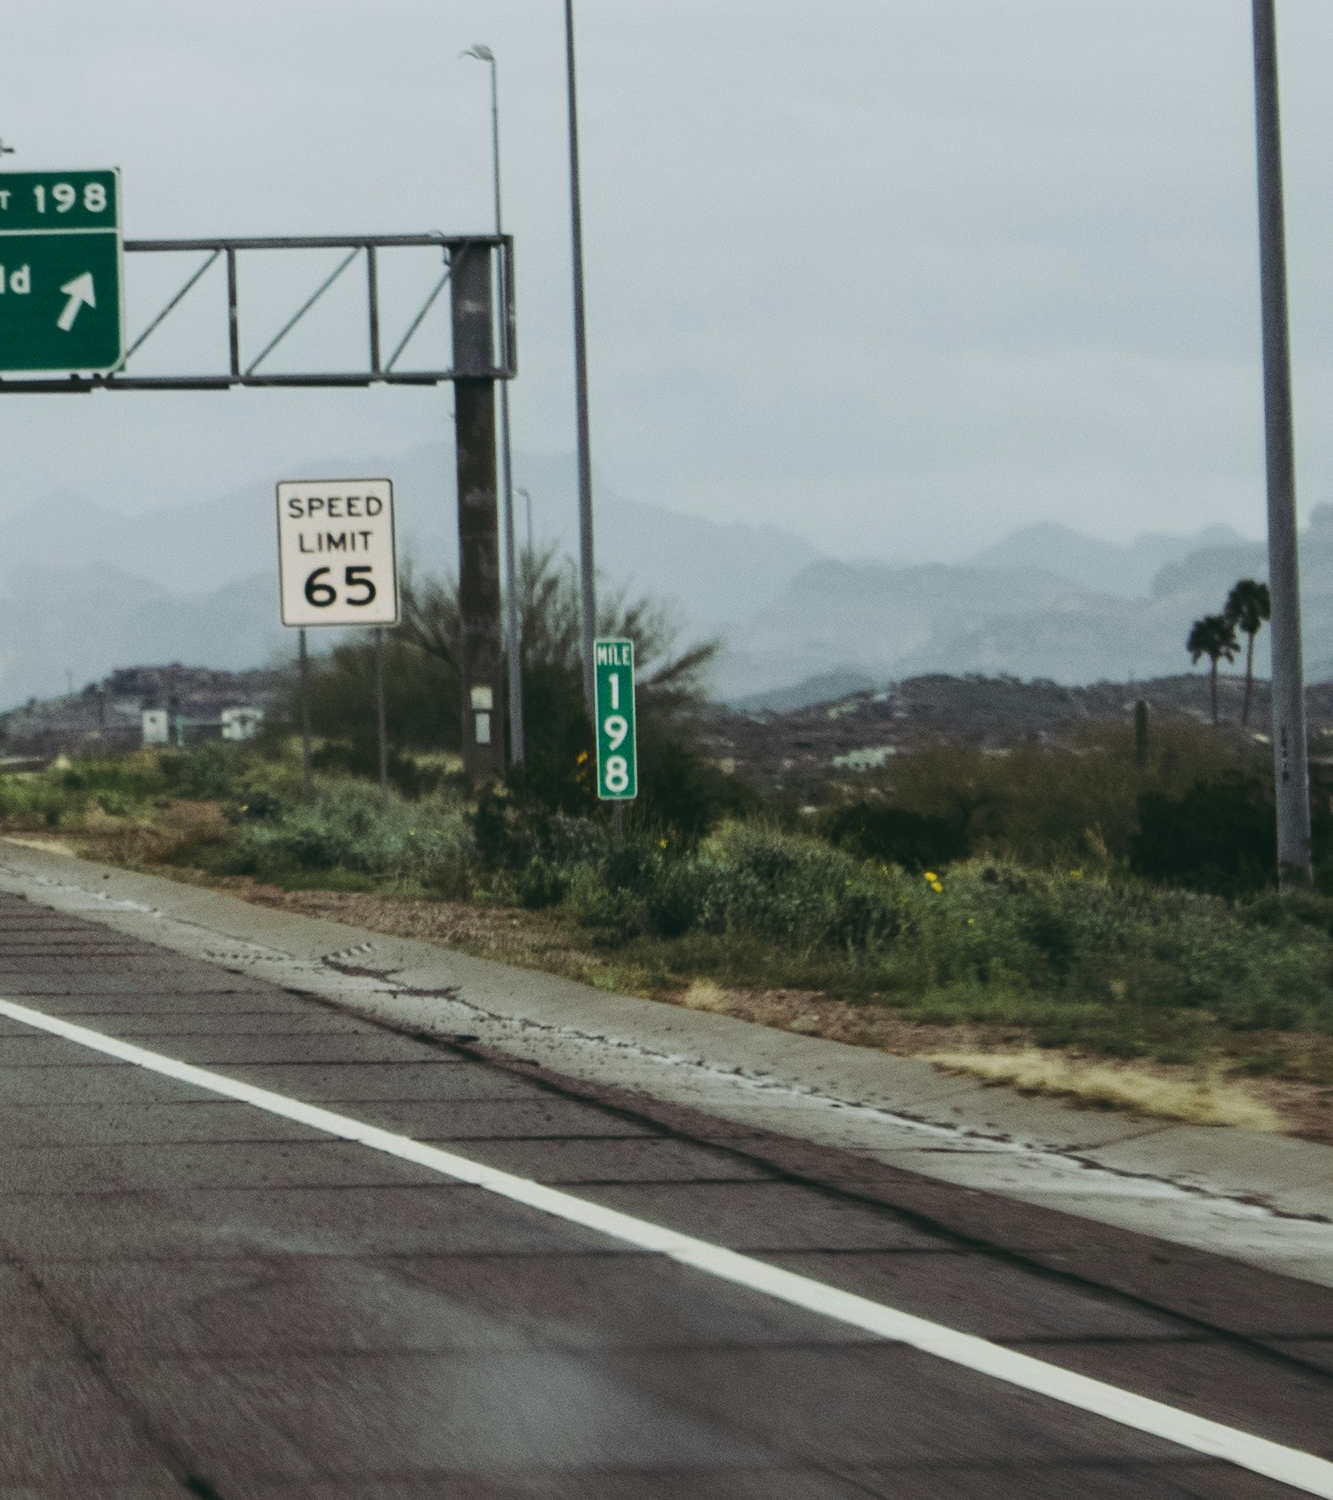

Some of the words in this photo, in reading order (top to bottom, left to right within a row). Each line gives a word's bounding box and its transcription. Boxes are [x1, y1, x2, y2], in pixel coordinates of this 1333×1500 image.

[33, 182, 107, 214] 198
[288, 496, 383, 519] SPEED
[298, 531, 374, 553] LIMIT
[304, 566, 376, 607] 65
[597, 645, 631, 666] MILE
